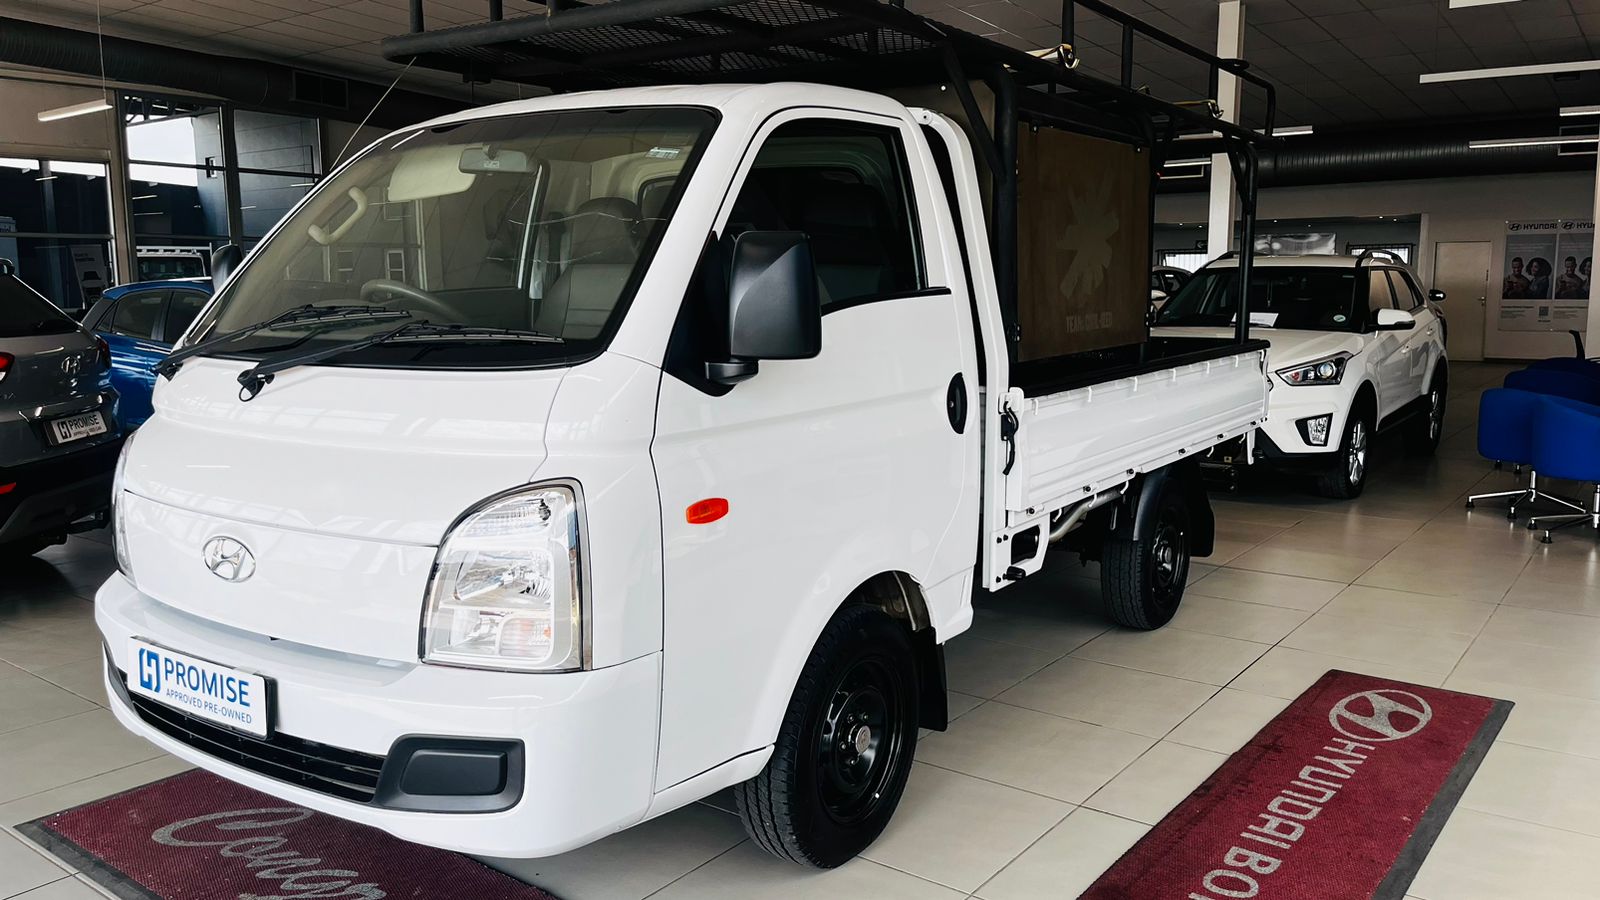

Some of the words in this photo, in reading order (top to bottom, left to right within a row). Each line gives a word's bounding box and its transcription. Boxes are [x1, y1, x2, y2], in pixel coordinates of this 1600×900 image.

[70, 414, 100, 430] PROMISE
[164, 657, 251, 707] PROMISE
[166, 688, 203, 708] APPROVED
[204, 701, 252, 724] PRE-OWNED
[1241, 737, 1376, 849] HYUNDAI
[1188, 846, 1283, 900] BO
